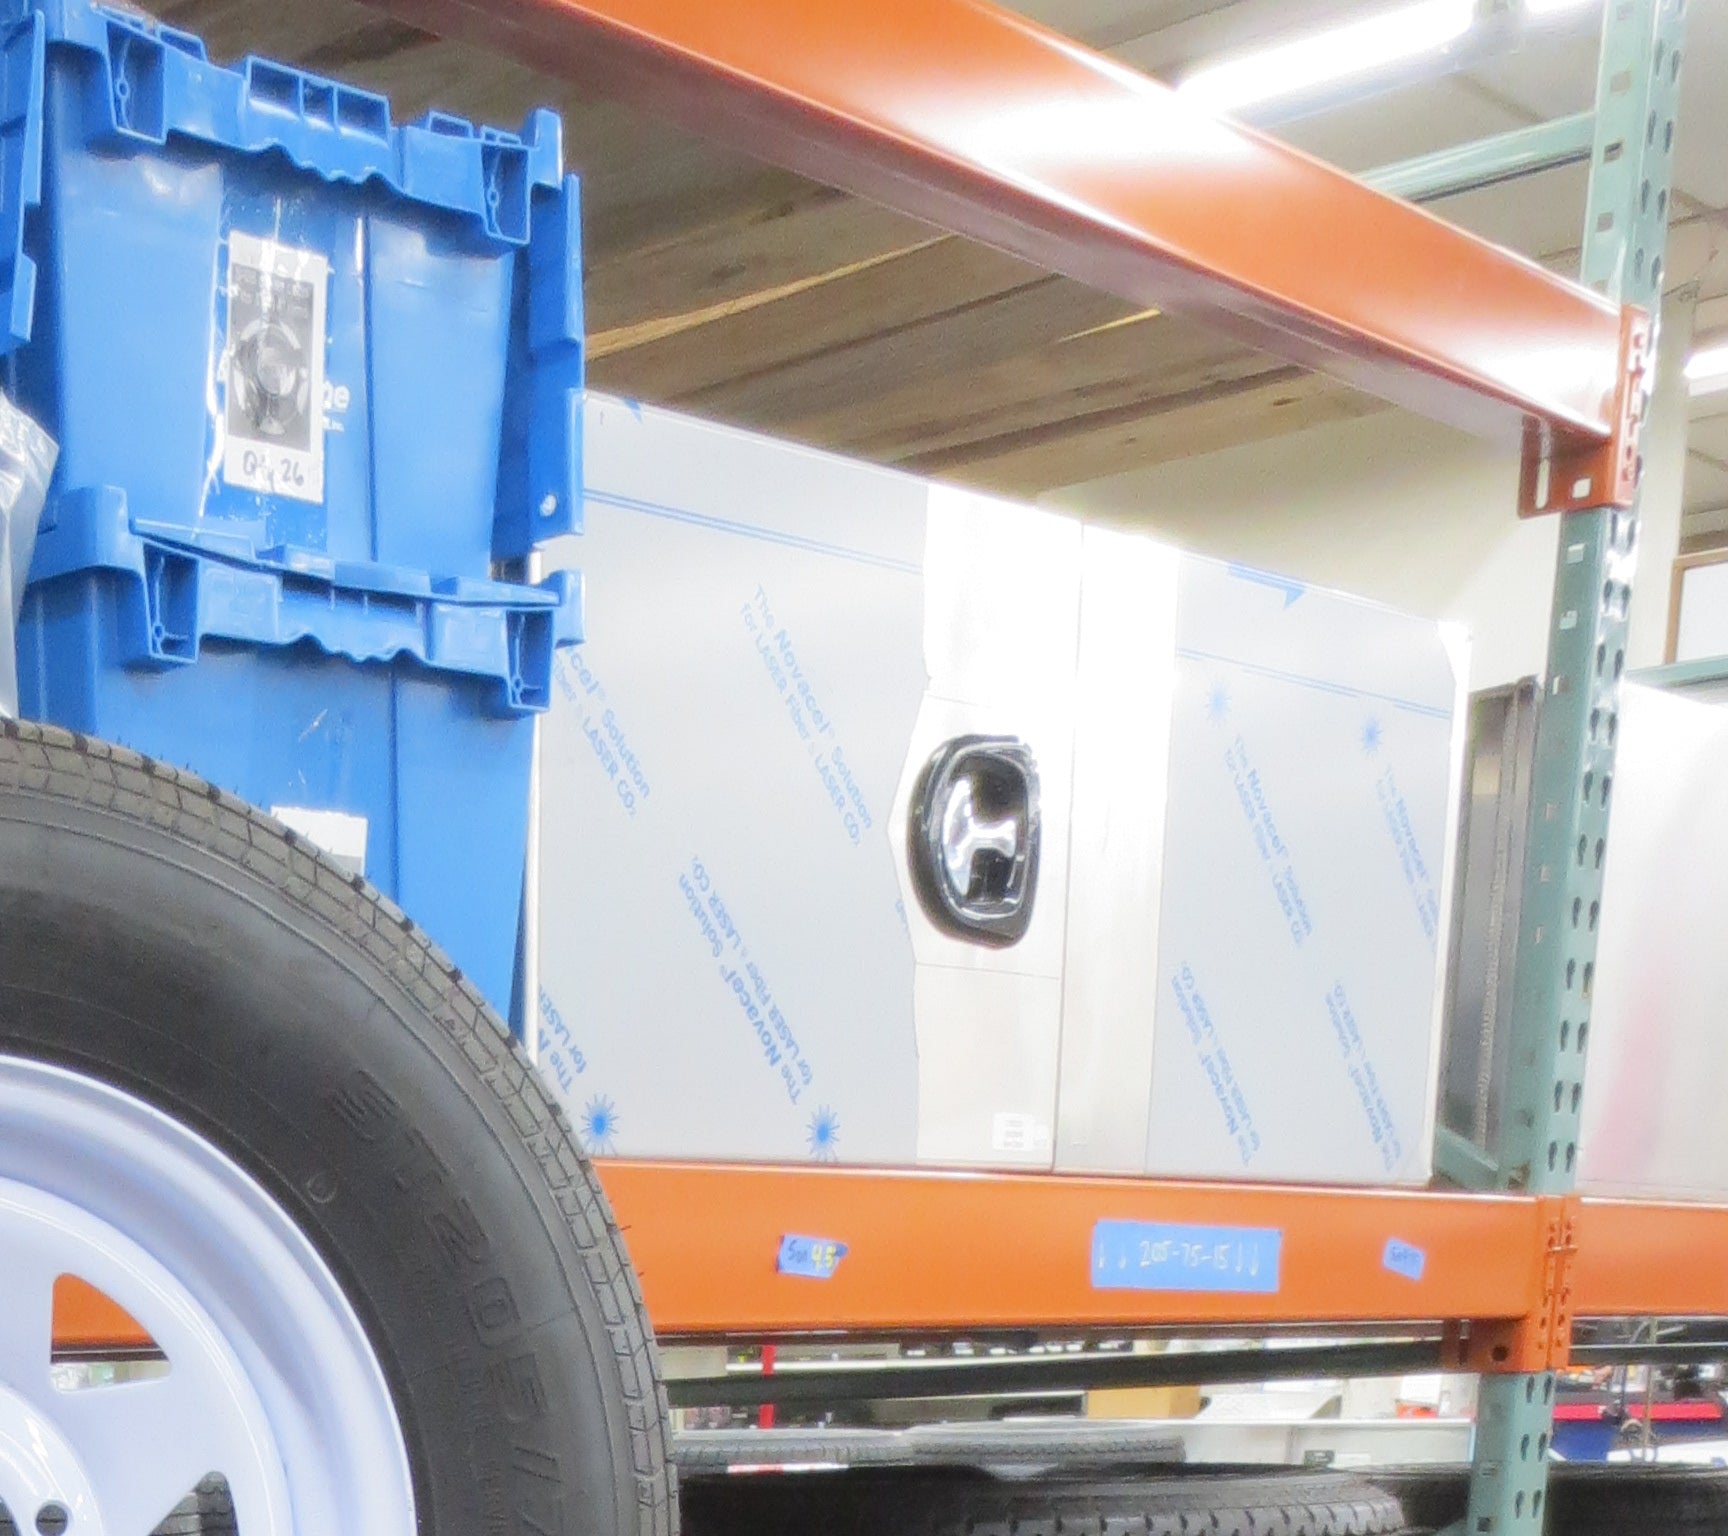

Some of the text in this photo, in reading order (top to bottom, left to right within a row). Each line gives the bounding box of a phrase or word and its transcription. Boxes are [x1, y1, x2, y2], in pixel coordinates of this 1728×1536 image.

[740, 603, 758, 633] for
[755, 633, 788, 695] LASER
[814, 754, 845, 814] LASER
[754, 583, 775, 628] The
[831, 745, 872, 829] Solution
[582, 716, 619, 780] LASER
[602, 709, 650, 799] Solution
[679, 872, 723, 958] Solution
[707, 889, 742, 950] LASER
[568, 1045, 587, 1075] for
[768, 1003, 800, 1061] LASER
[550, 1051, 573, 1095] The
[781, 1063, 801, 1105] The
[797, 1057, 813, 1087] for
